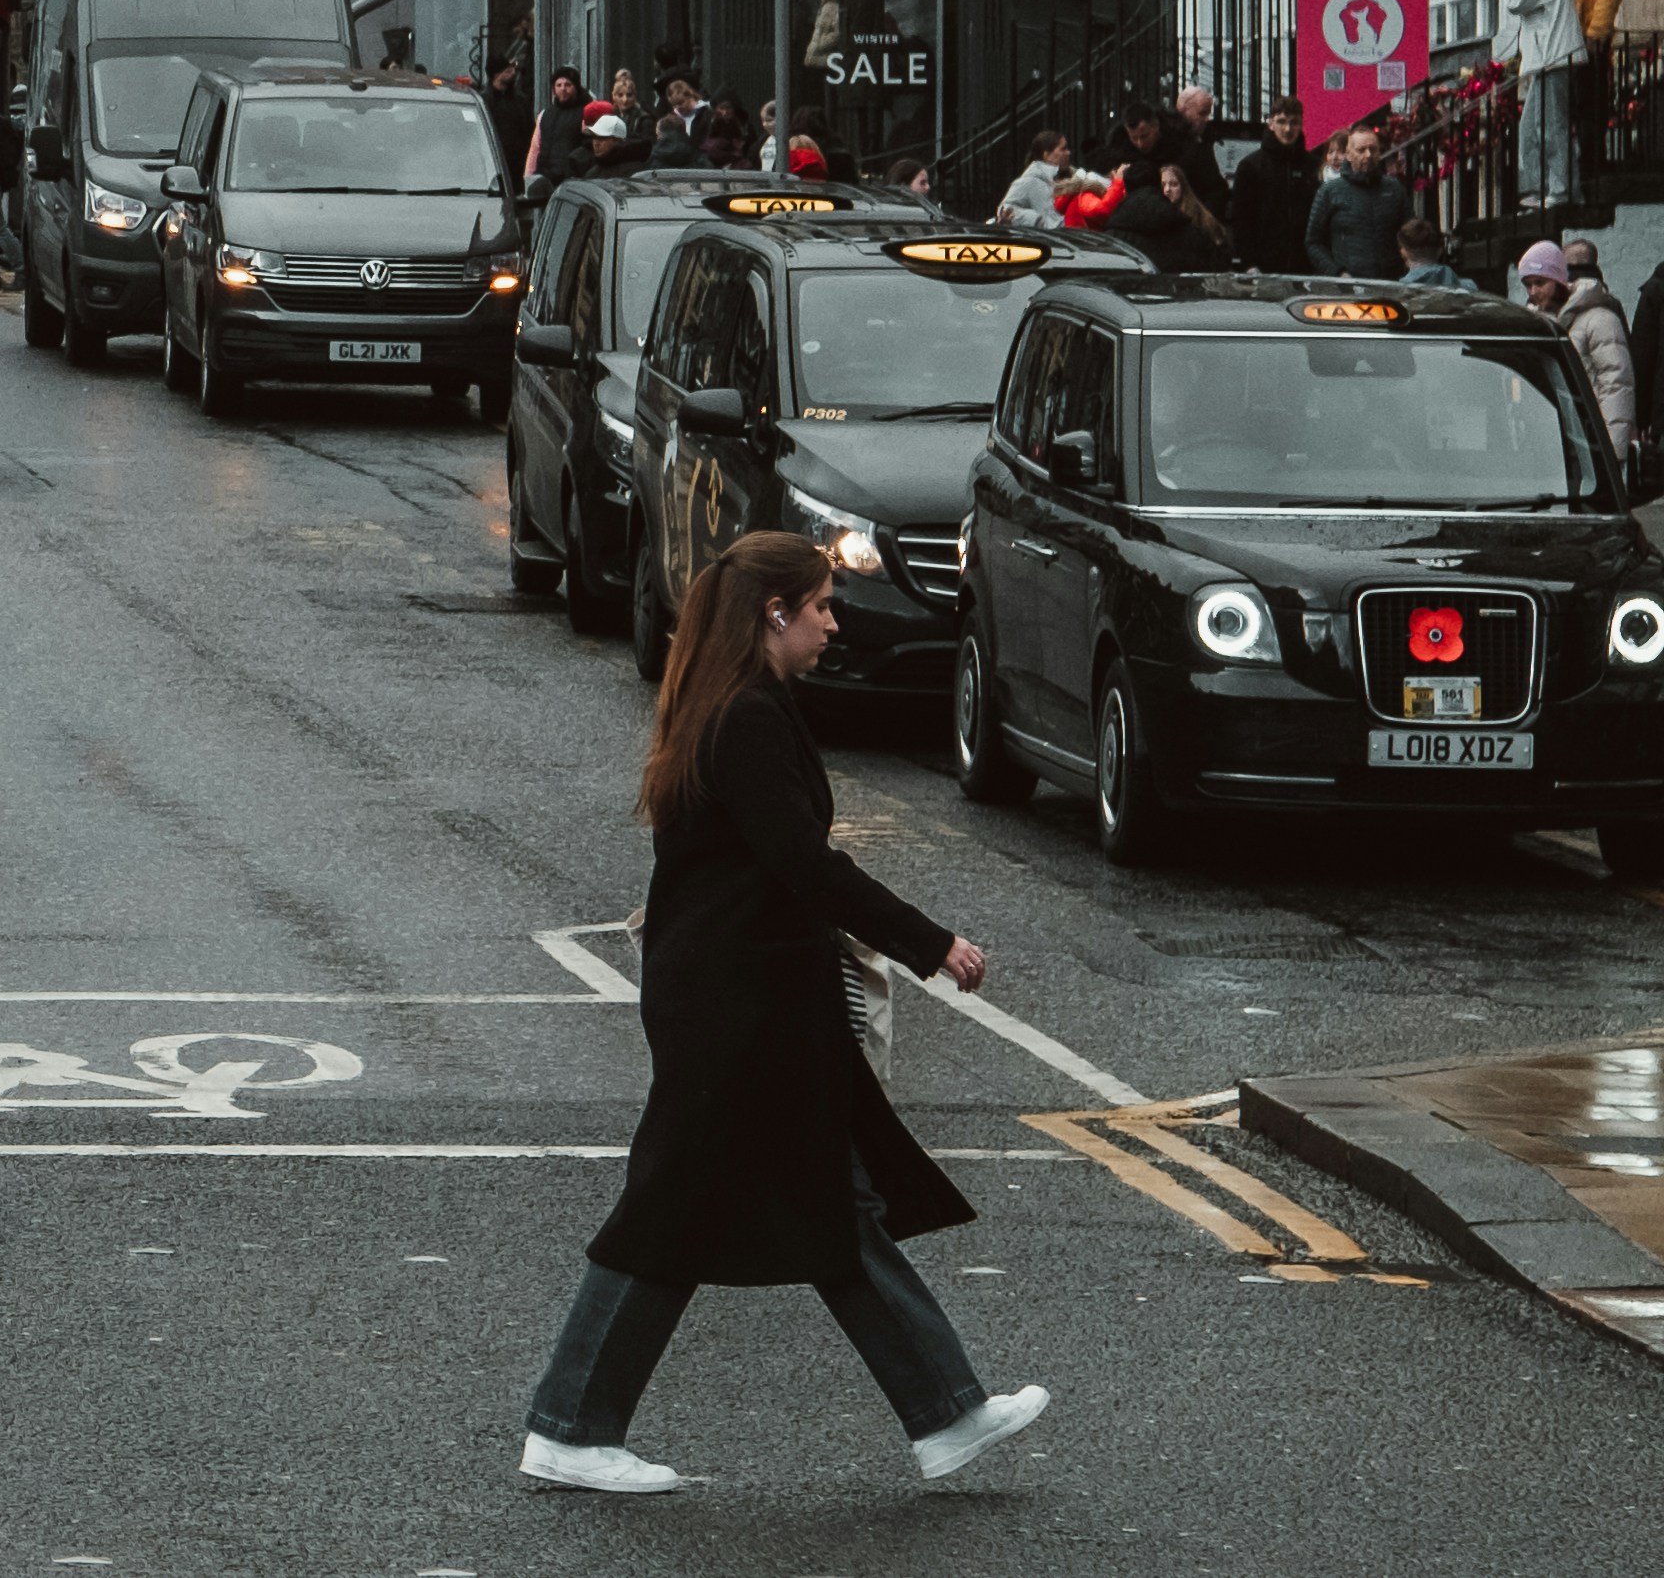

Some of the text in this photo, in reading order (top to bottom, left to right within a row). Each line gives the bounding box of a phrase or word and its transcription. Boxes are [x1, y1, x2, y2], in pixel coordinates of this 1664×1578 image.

[853, 33, 899, 44] WINTER
[825, 52, 929, 85] SALE
[749, 199, 816, 213] TAXI
[938, 246, 1012, 263] TAXI
[1313, 305, 1392, 320] TAXI
[339, 343, 411, 360] GL21 JXK
[803, 407, 848, 421] P302
[1459, 736, 1514, 764] XDZ
